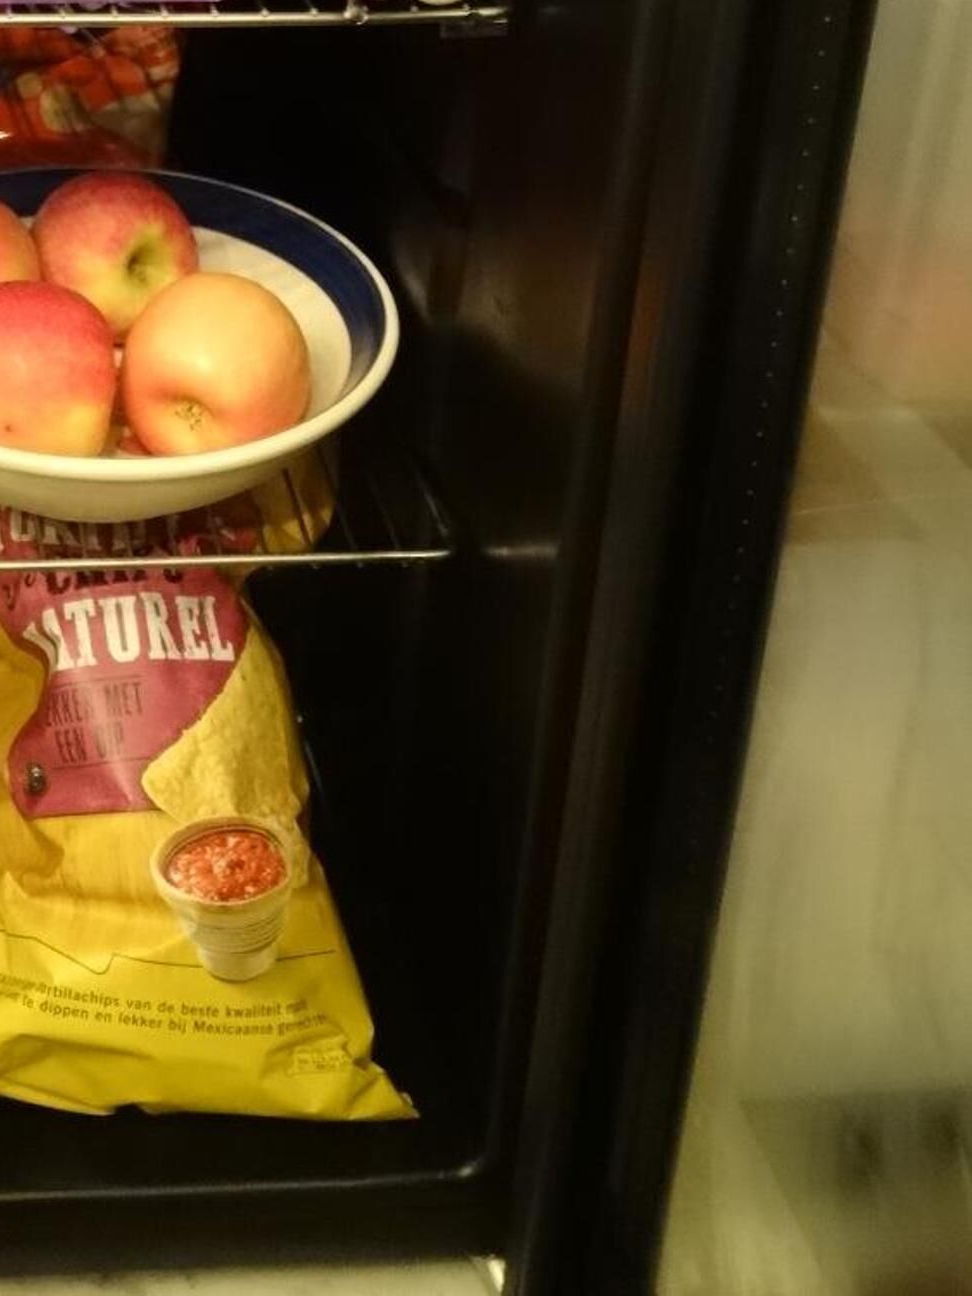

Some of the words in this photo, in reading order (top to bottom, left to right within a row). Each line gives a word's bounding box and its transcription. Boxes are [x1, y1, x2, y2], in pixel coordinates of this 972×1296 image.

[39, 999, 89, 1021] dippen
[94, 1010, 112, 1023] en
[117, 1012, 163, 1030] lekker
[167, 1017, 188, 1034] bij
[192, 1019, 274, 1036] Mexicaanse
[157, 1001, 175, 1013] de
[180, 1003, 219, 1018] beste
